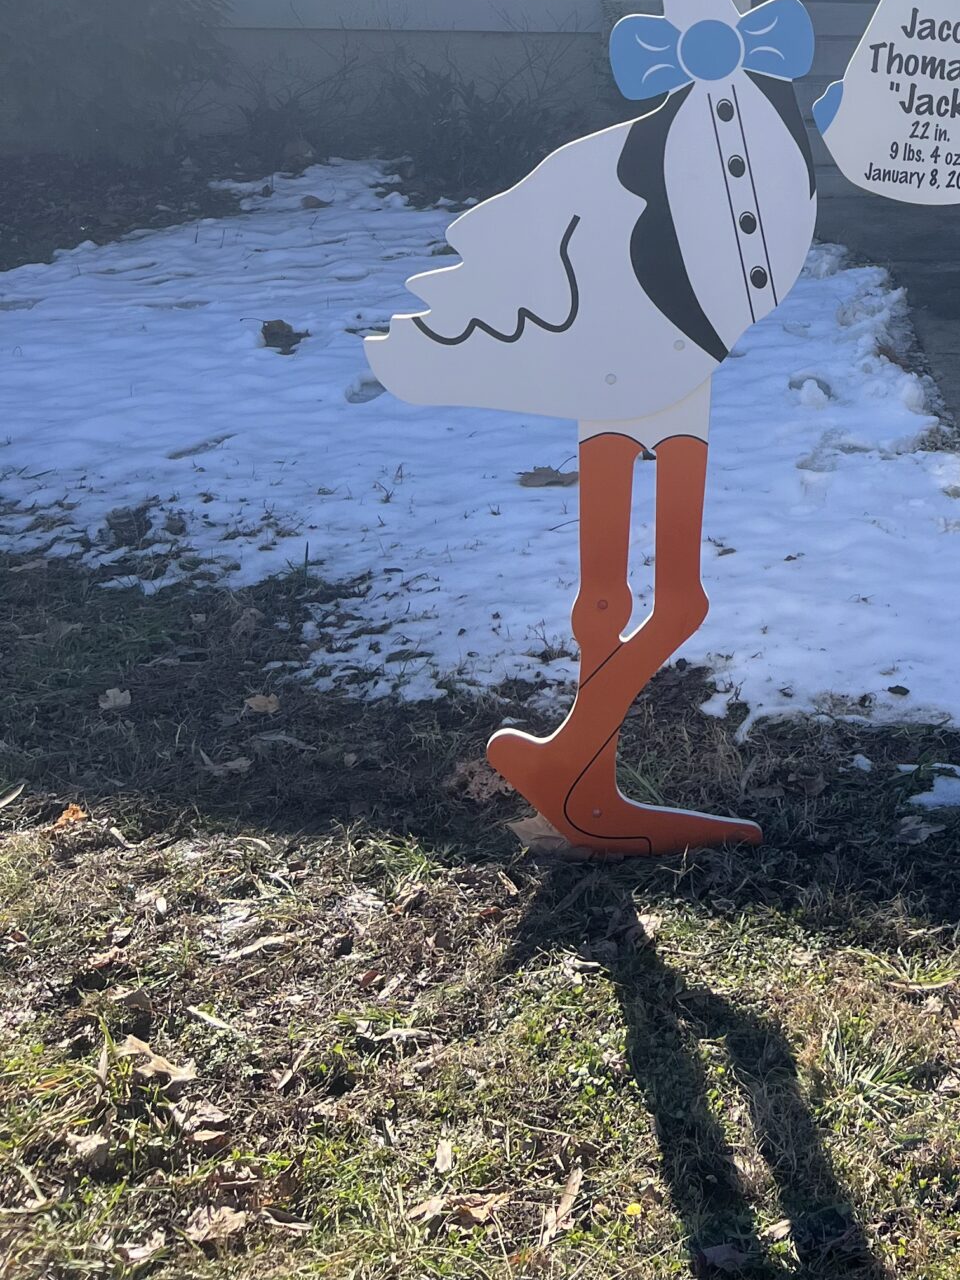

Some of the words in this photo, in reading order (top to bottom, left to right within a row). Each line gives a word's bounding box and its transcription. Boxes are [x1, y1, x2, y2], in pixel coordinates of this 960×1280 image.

[909, 120, 930, 140] 22
[934, 123, 950, 142] in.
[889, 141, 899, 160] 9
[903, 142, 925, 163] lbs.
[930, 145, 941, 164] 4
[864, 162, 925, 189] January
[929, 168, 940, 189] 8,
